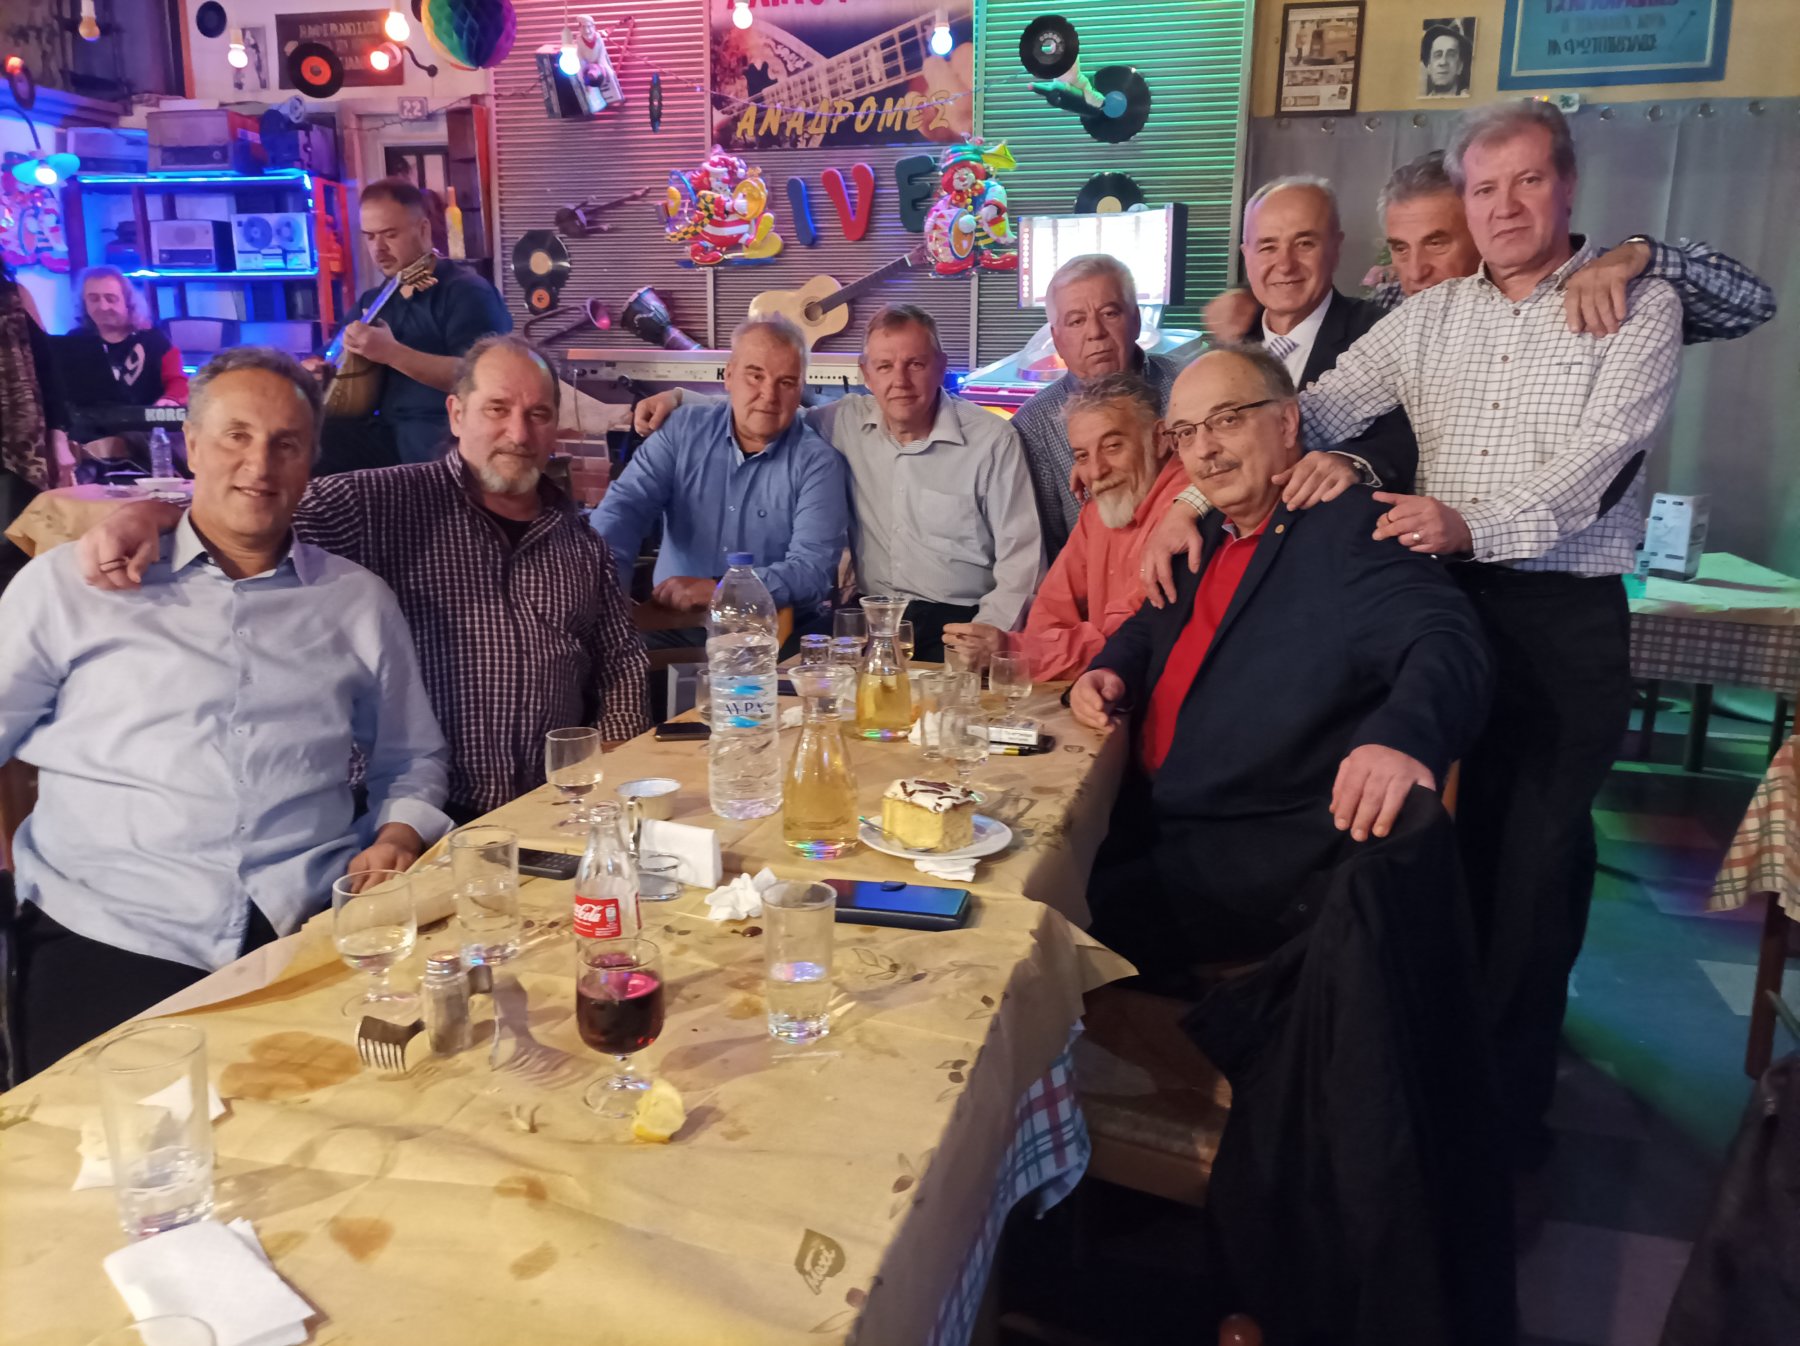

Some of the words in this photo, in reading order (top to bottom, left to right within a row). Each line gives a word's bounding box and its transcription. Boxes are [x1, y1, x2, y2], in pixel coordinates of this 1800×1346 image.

[403, 101, 422, 117] 22
[736, 92, 950, 138] ΑΝΑΔΡΟΜΕΣ
[742, 154, 936, 258] IVE
[145, 408, 187, 421] KORG
